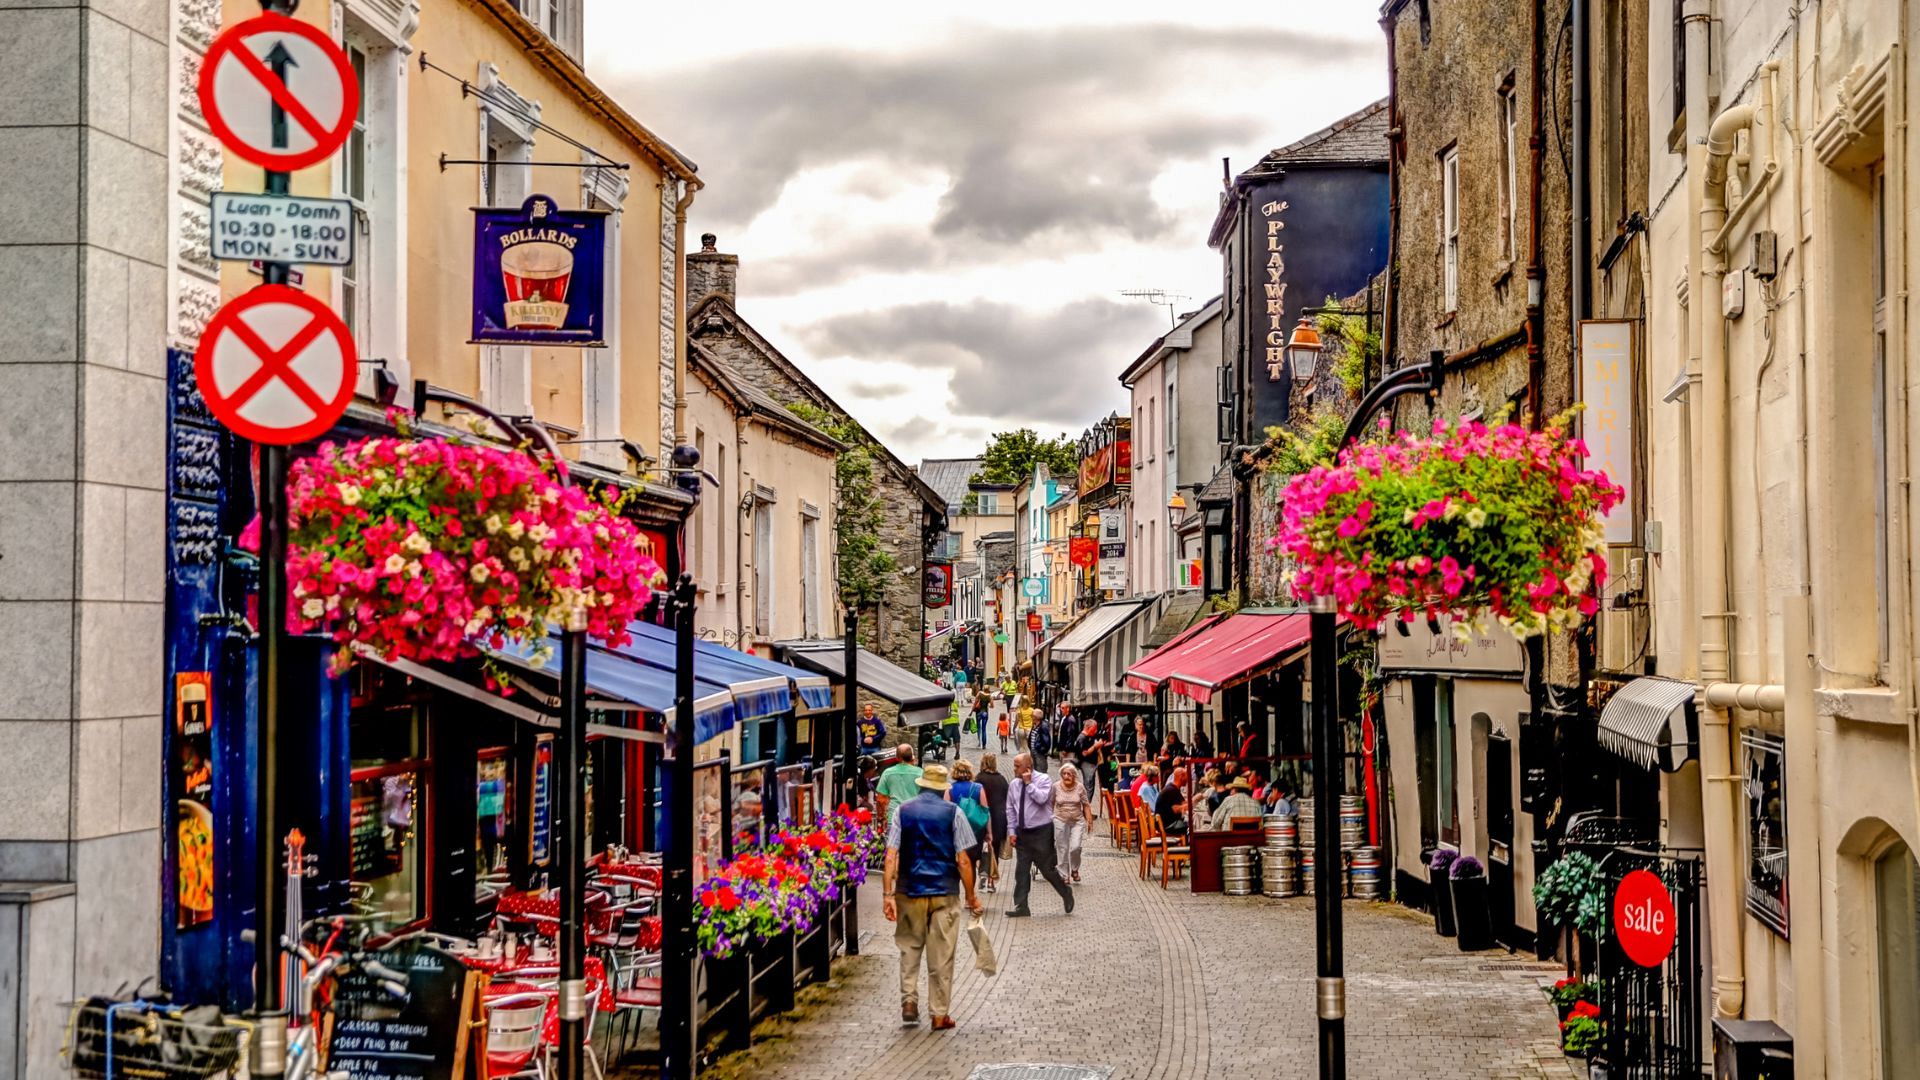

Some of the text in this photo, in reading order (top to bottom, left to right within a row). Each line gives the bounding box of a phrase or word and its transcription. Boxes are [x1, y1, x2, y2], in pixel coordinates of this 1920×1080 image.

[226, 199, 271, 216] Luan
[286, 202, 340, 220] Domh
[220, 220, 276, 238] 10:30
[292, 223, 346, 242] 18:00
[500, 228, 577, 249] BOLLARDS
[222, 240, 279, 258] MON.
[294, 243, 345, 260] SUN.
[1262, 200, 1289, 381] The PLAYWRIGHT
[1624, 897, 1665, 935] sale
[336, 1058, 361, 1071] APPLE
